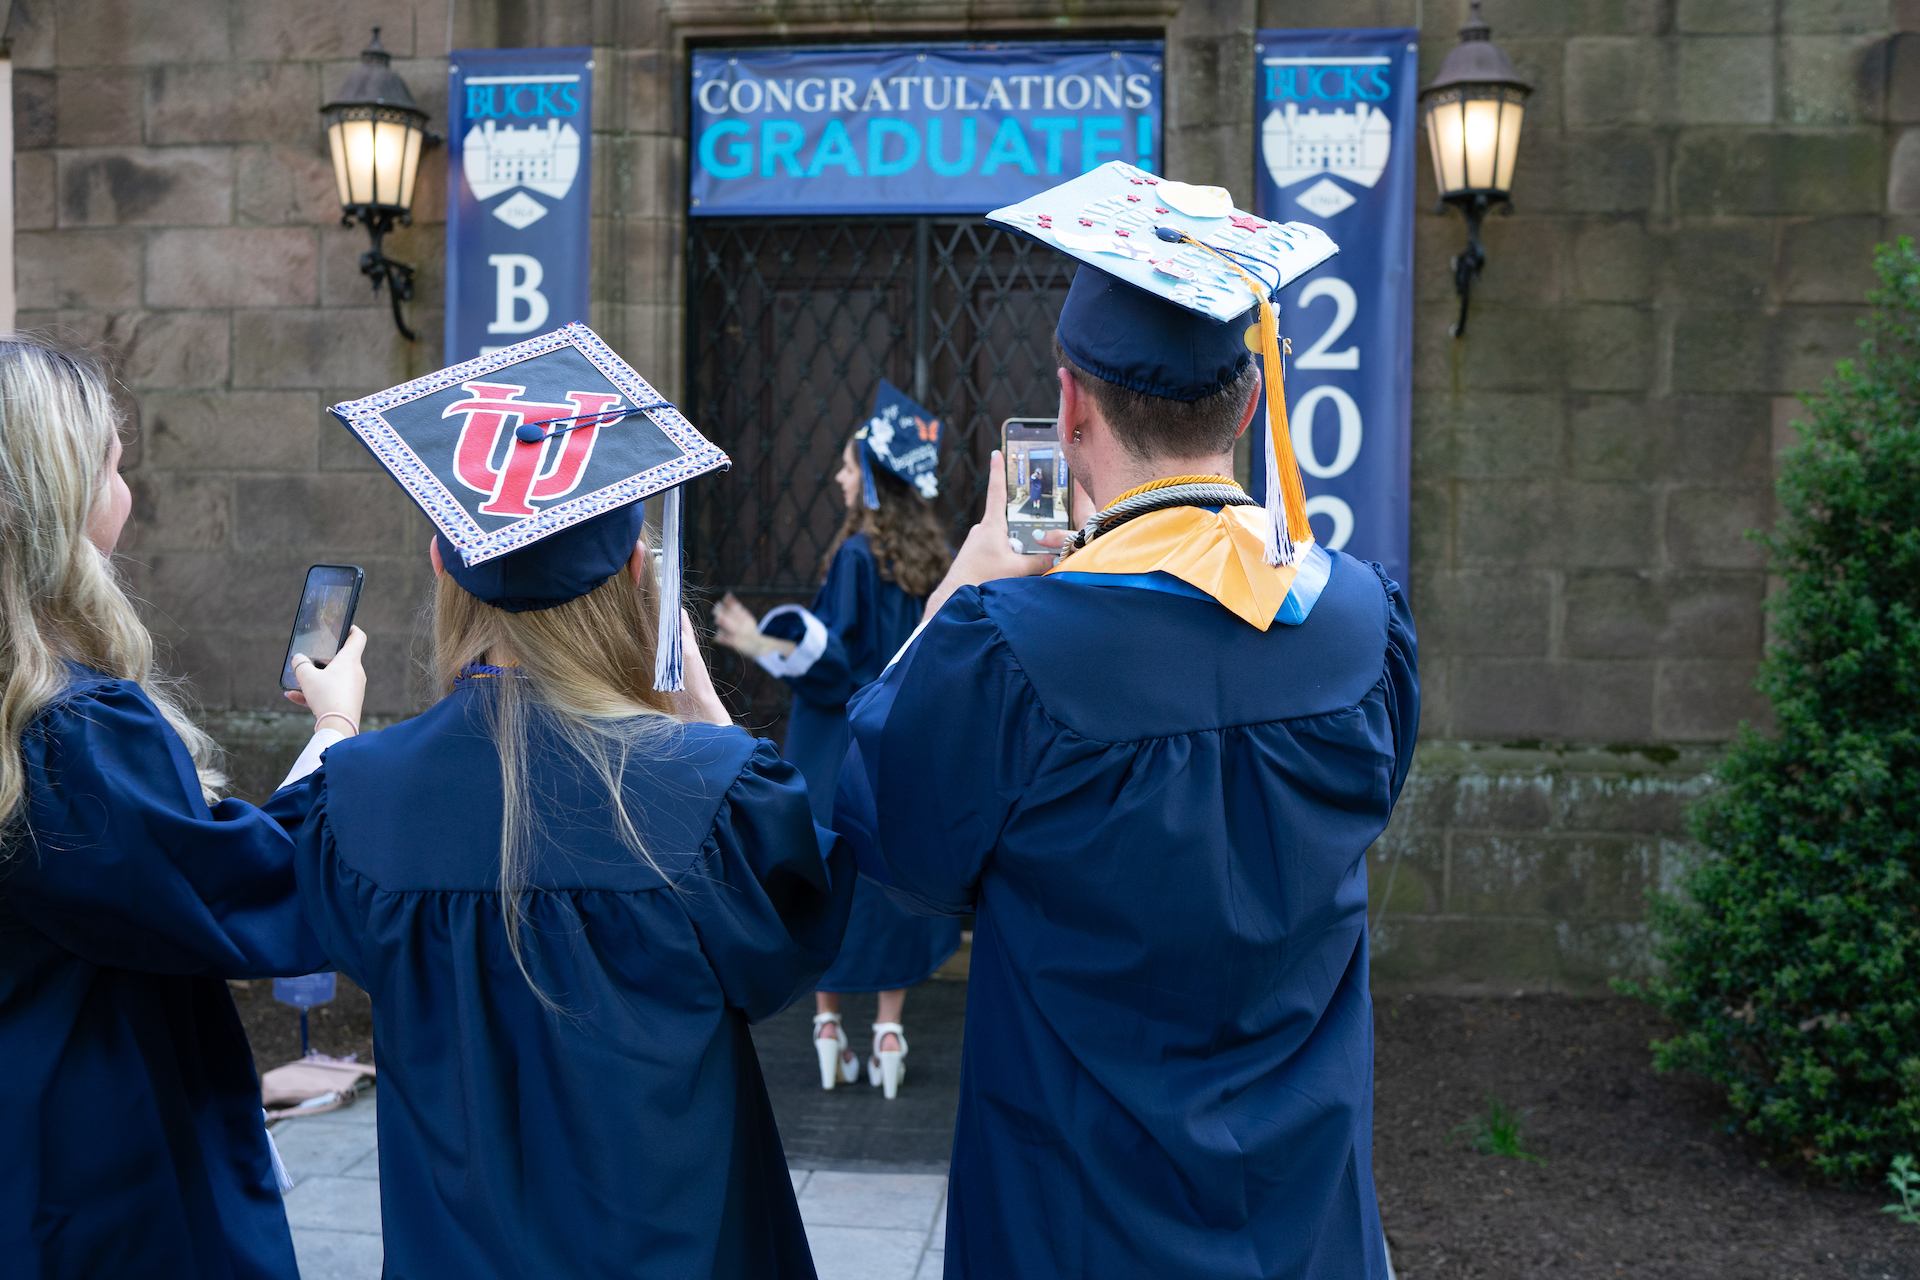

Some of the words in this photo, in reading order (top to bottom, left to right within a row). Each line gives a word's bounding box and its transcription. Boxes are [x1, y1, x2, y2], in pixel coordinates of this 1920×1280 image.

[464, 83, 581, 119] BUCKS
[699, 74, 1153, 114] CONGRATULATIONS
[1264, 66, 1392, 101] BUCKS
[699, 115, 1155, 180] GRADUATE!
[1078, 195, 1136, 226] NEXT
[1116, 206, 1161, 233] STOP
[1172, 225, 1254, 268] UTMPA
